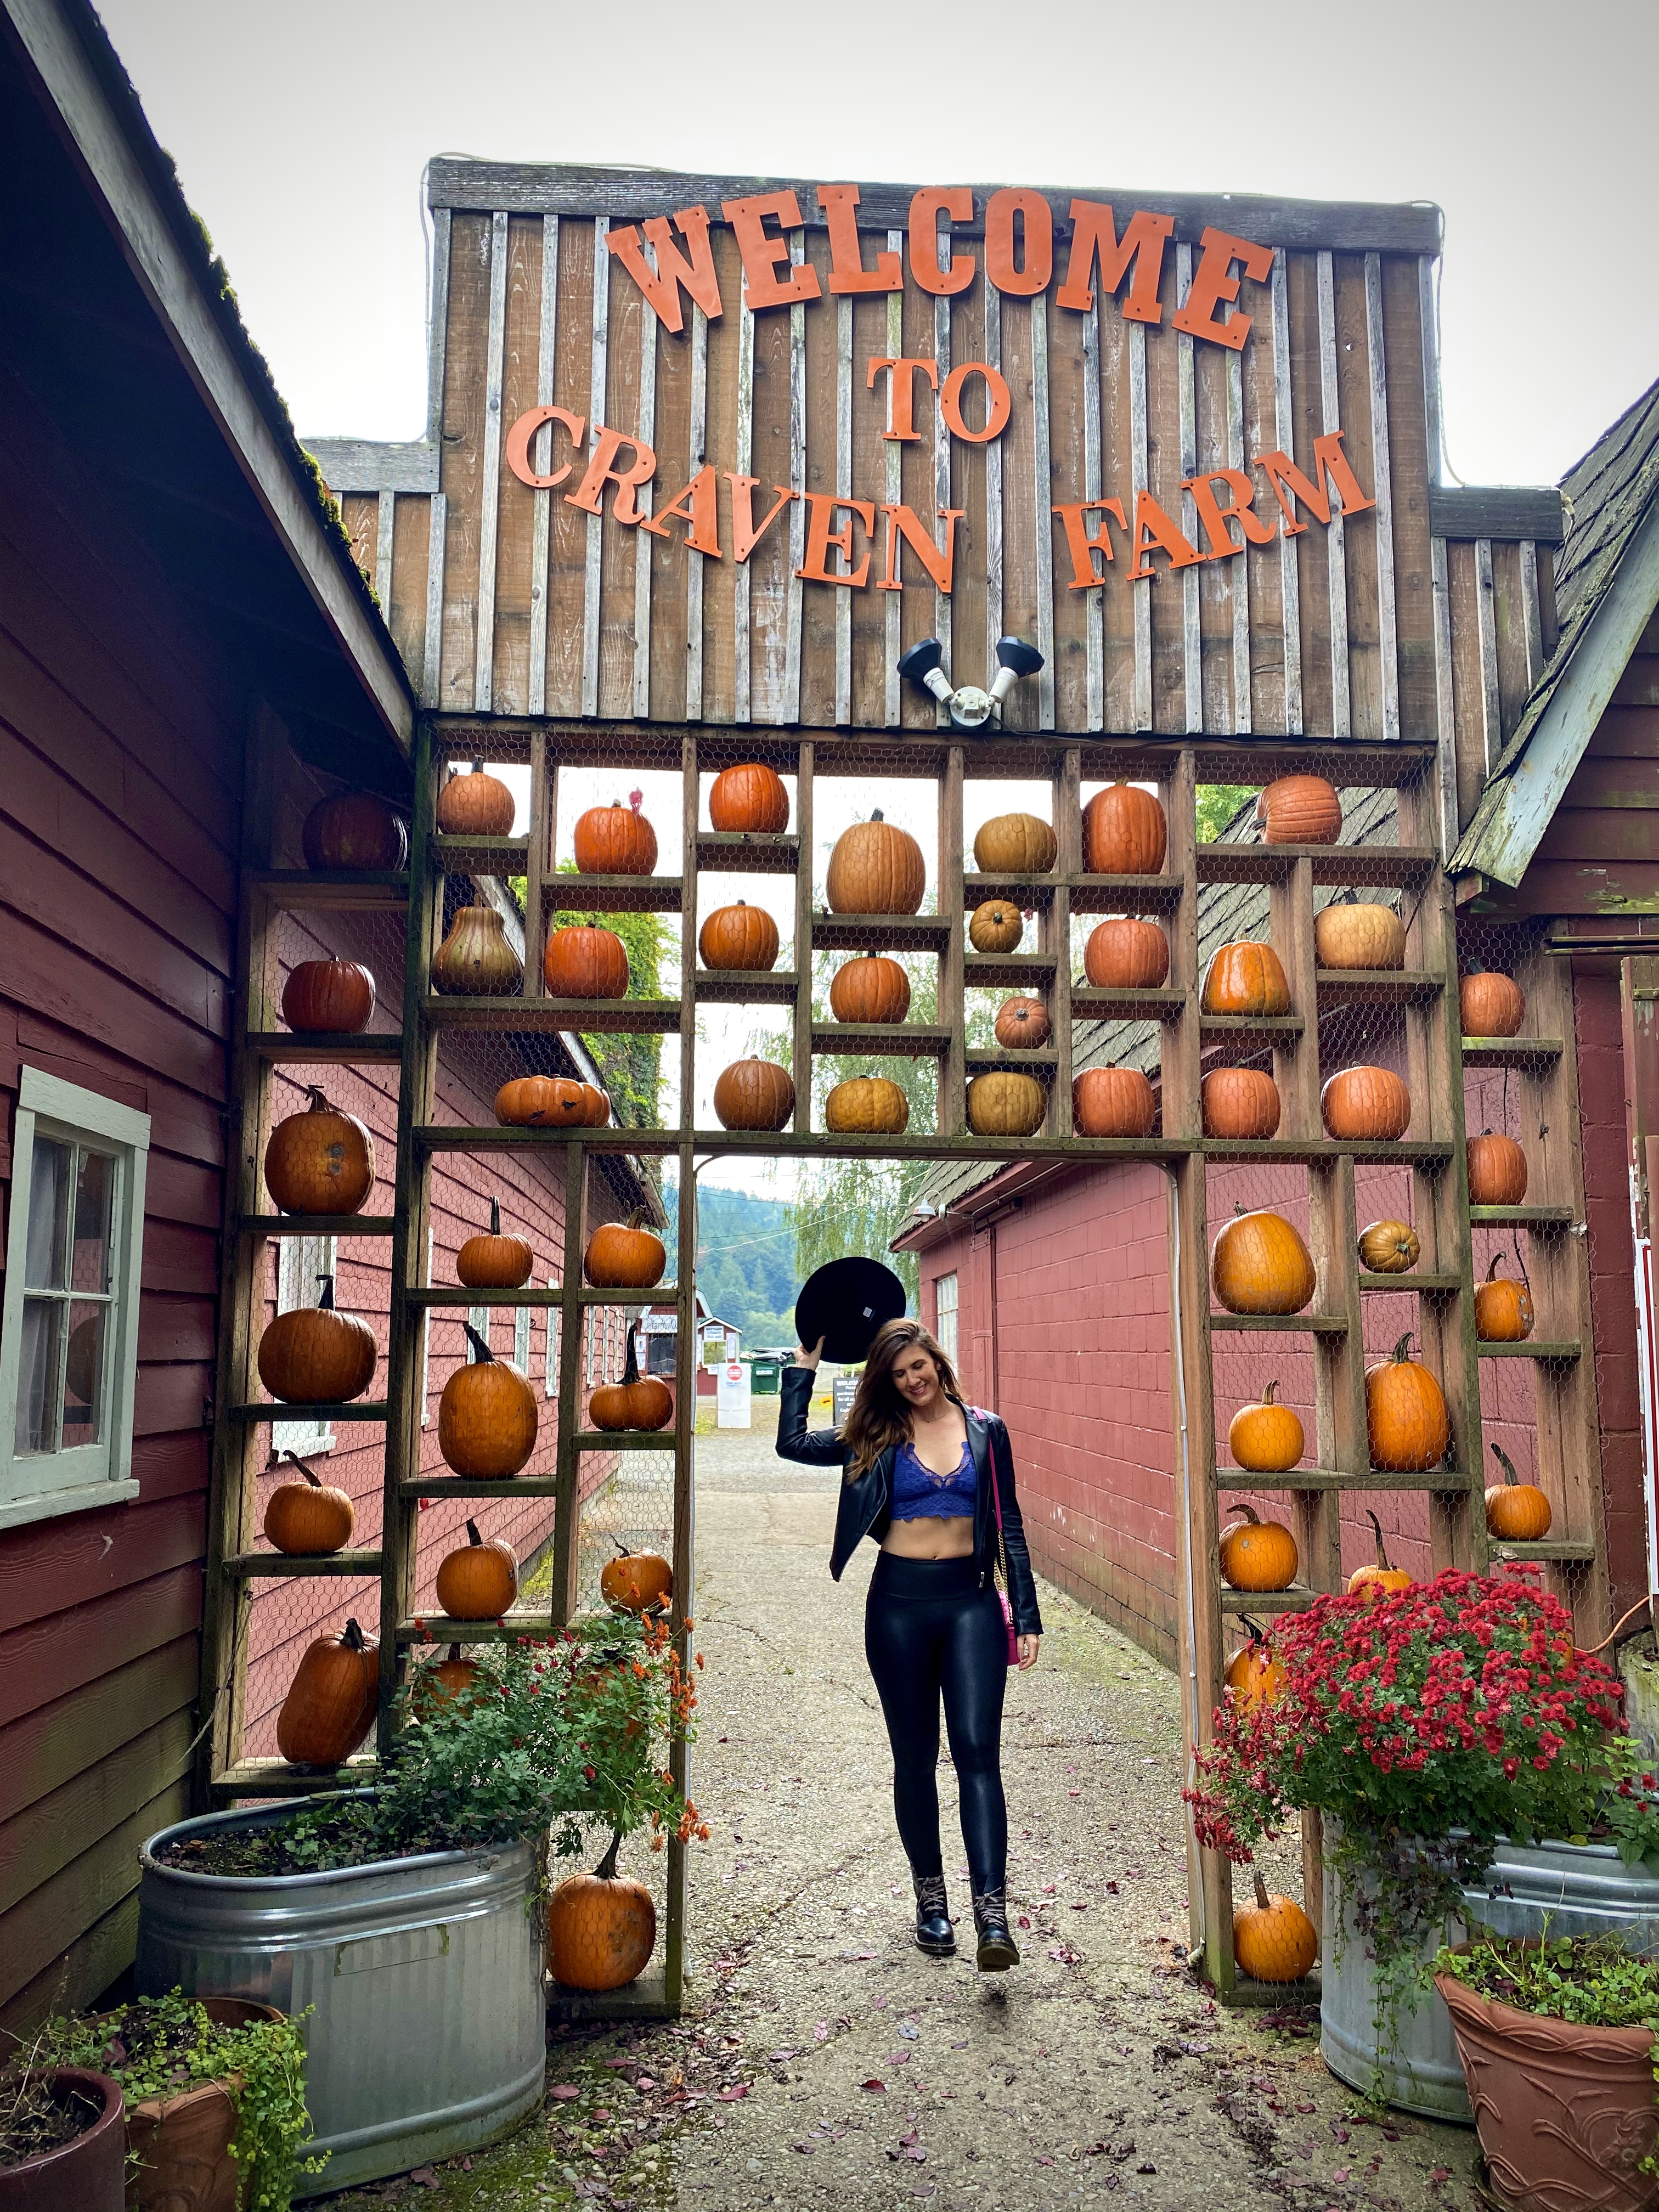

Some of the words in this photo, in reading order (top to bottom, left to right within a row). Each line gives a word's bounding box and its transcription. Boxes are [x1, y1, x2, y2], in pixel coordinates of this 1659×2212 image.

[606, 185, 1273, 350] WELCOME
[867, 357, 1011, 442] TO
[507, 406, 964, 592] CRAVEN
[1052, 431, 1375, 589] FARM
